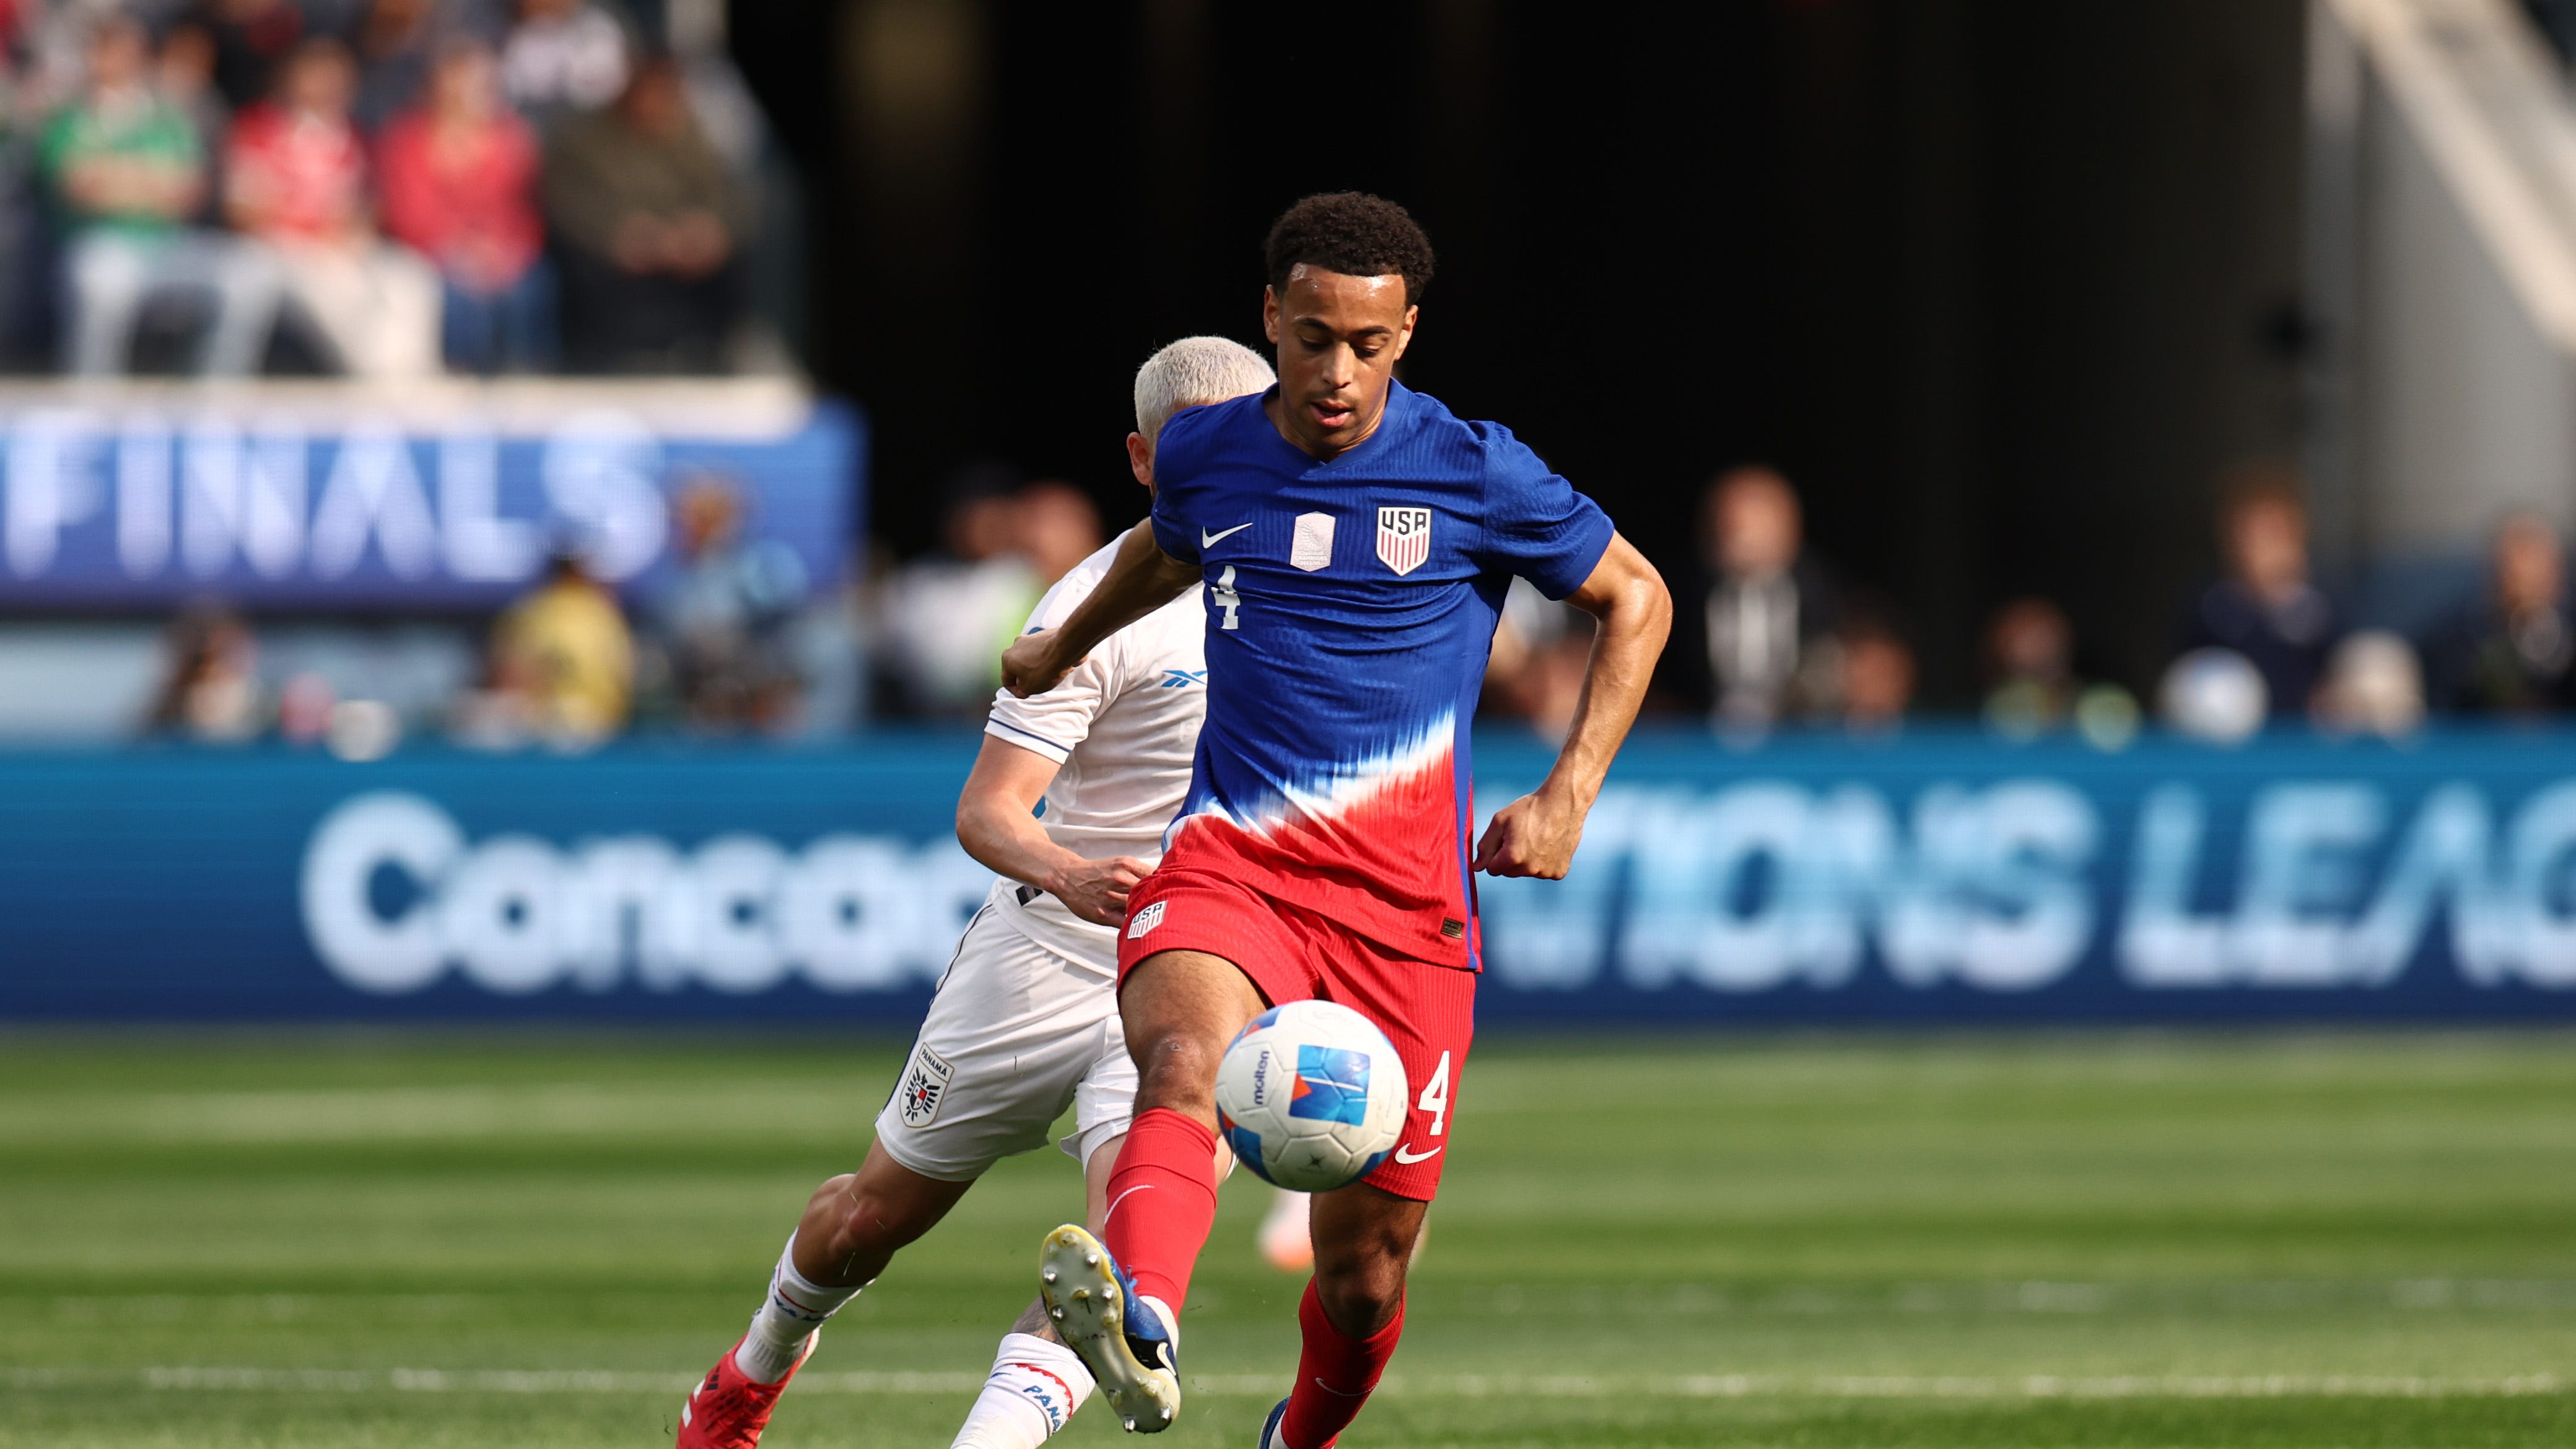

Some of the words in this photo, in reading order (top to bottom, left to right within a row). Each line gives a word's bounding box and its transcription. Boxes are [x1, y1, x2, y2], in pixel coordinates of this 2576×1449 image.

[4, 410, 670, 582] FINALS
[1382, 510, 1426, 536] USA
[1132, 903, 1163, 925] USA
[1254, 1051, 1270, 1105] molten
[1417, 1050, 1450, 1136] 4
[1022, 1385, 1063, 1432] PANA
